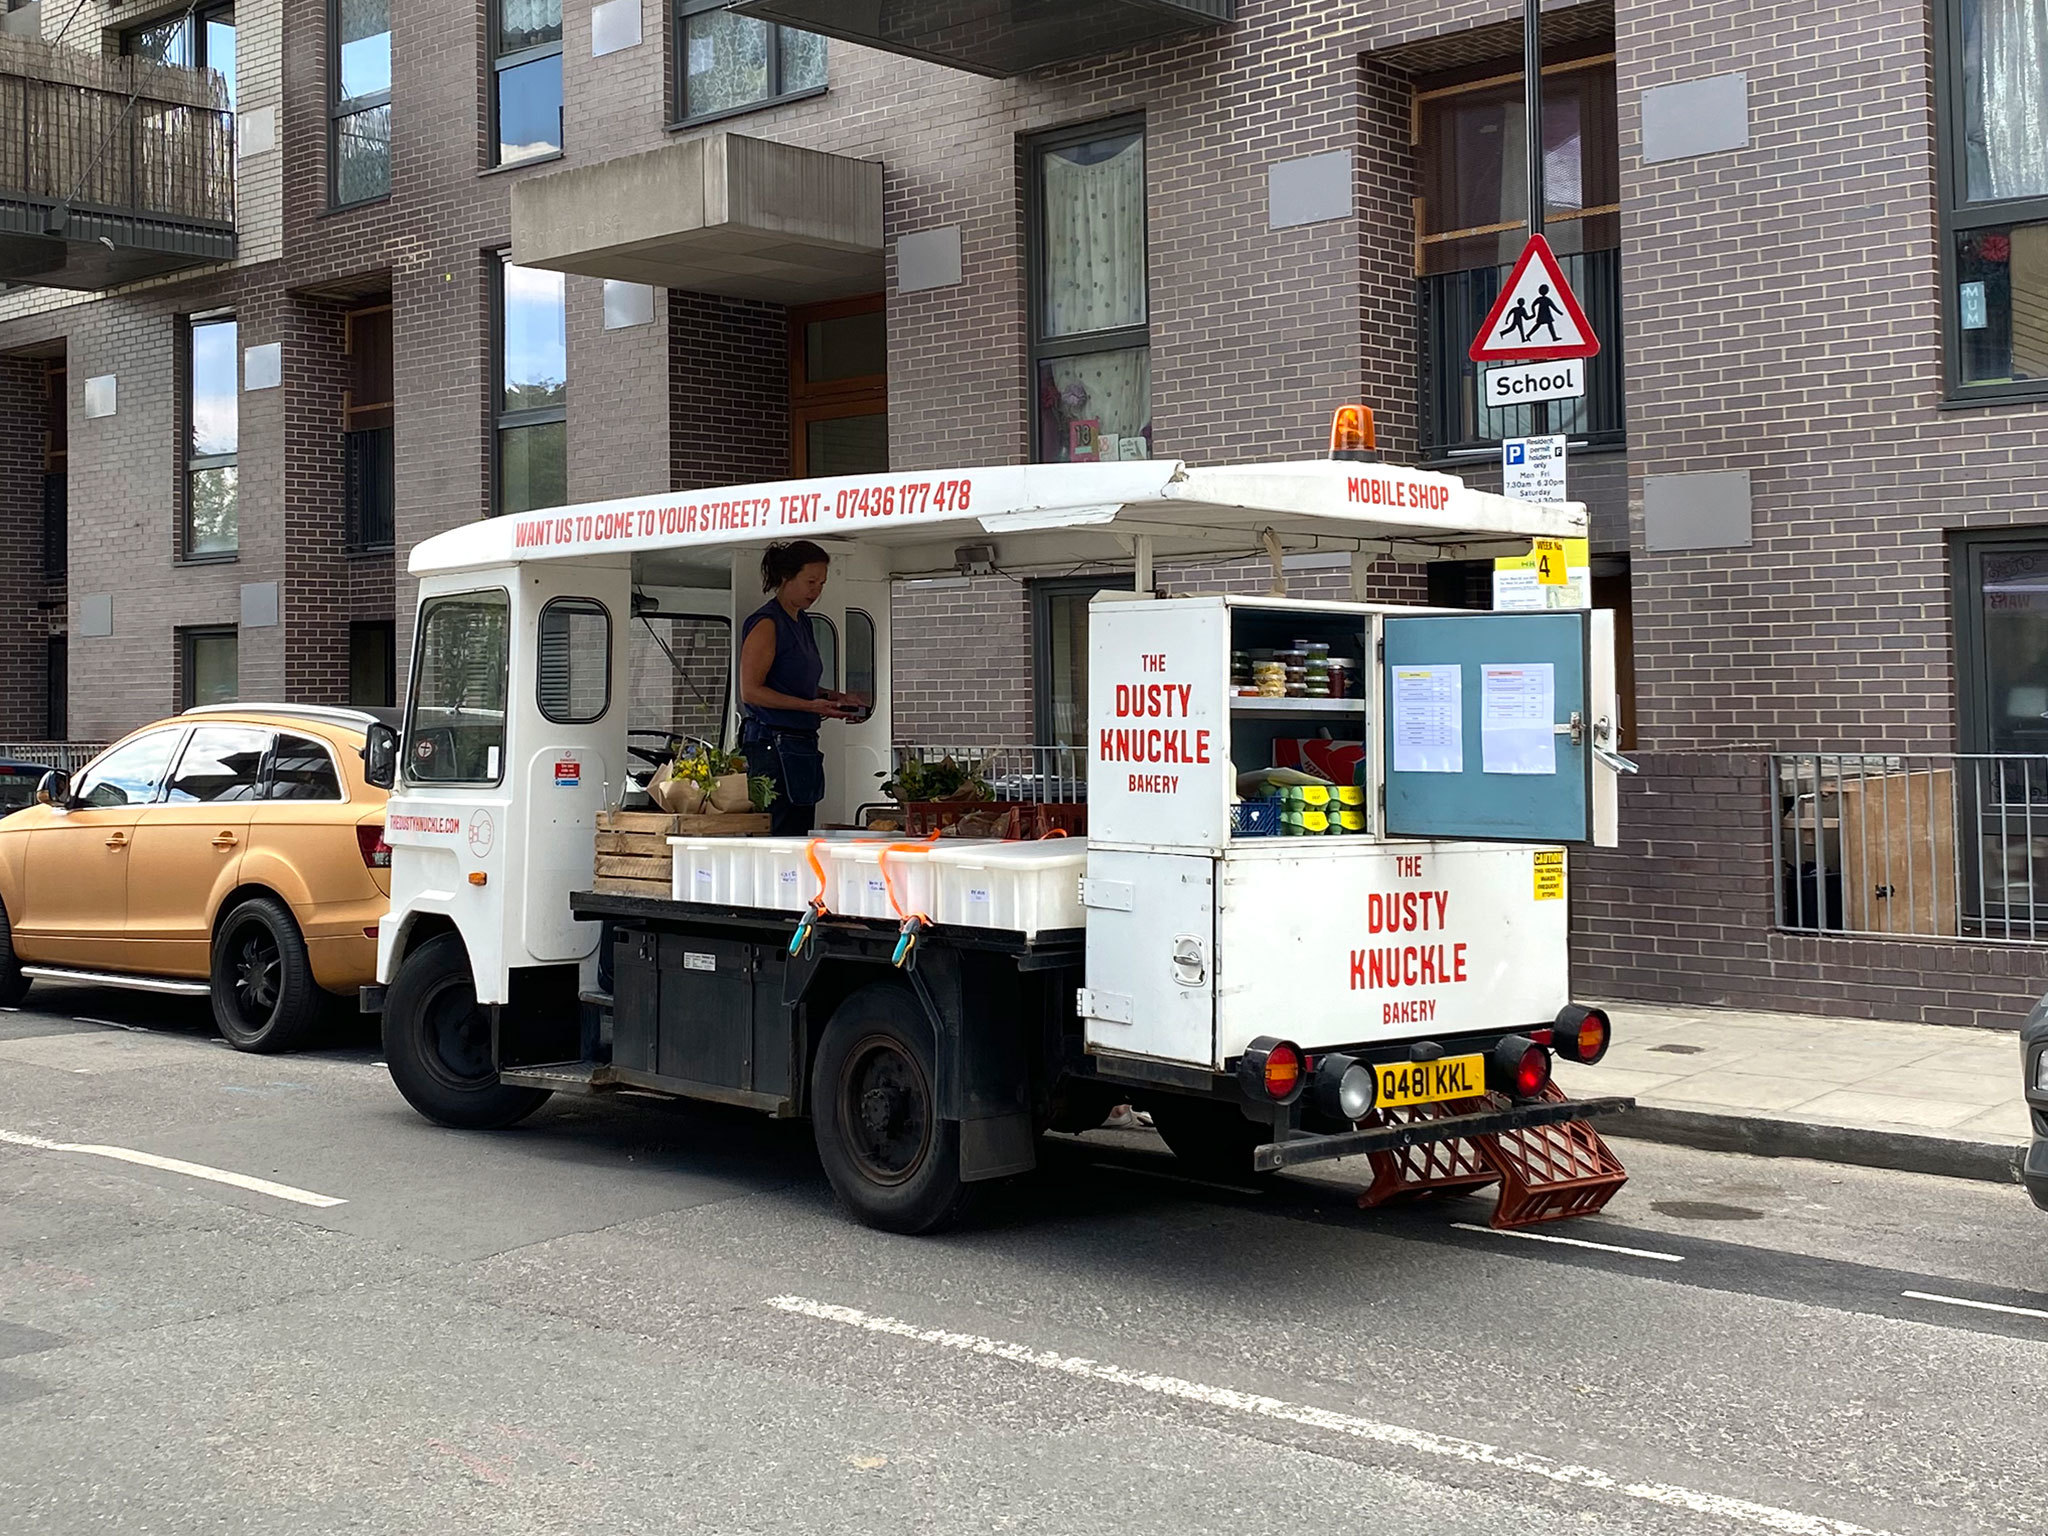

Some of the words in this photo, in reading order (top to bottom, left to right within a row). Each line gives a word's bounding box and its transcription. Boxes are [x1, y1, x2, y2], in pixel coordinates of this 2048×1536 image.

[1496, 369, 1574, 396] School
[1510, 446, 1521, 463] P
[1530, 446, 1550, 454] permit
[1347, 476, 1406, 507] MOBILE
[1408, 483, 1449, 511] SHOP
[1520, 489, 1551, 497] Saturday
[515, 519, 553, 548] WANT
[555, 517, 573, 544] US
[576, 515, 592, 542] TO
[595, 511, 634, 541] COME
[637, 509, 657, 537] TO
[659, 505, 697, 535] YOUR
[700, 498, 771, 532] STREET?
[780, 493, 821, 525] TEXT
[836, 486, 895, 519] 07436
[899, 483, 931, 514] 177
[933, 479, 972, 512] 478
[1537, 541, 1553, 550] WEEK
[1539, 555, 1551, 578] 4
[1141, 654, 1166, 672] THE
[1116, 684, 1192, 717] DUSTY
[1100, 728, 1210, 764] KNUCKLE
[1128, 774, 1179, 794] BAKERY
[390, 815, 460, 834] THEDUSTYKNUCKLE.COM
[1396, 856, 1422, 877] THE
[1535, 852, 1563, 864] CAUTION
[1368, 890, 1448, 934] DUSTY
[1350, 943, 1467, 990] KNUCKLE
[1383, 999, 1436, 1025] BAKERY
[1383, 1066, 1430, 1099] Q481
[1436, 1062, 1473, 1094] KKL
